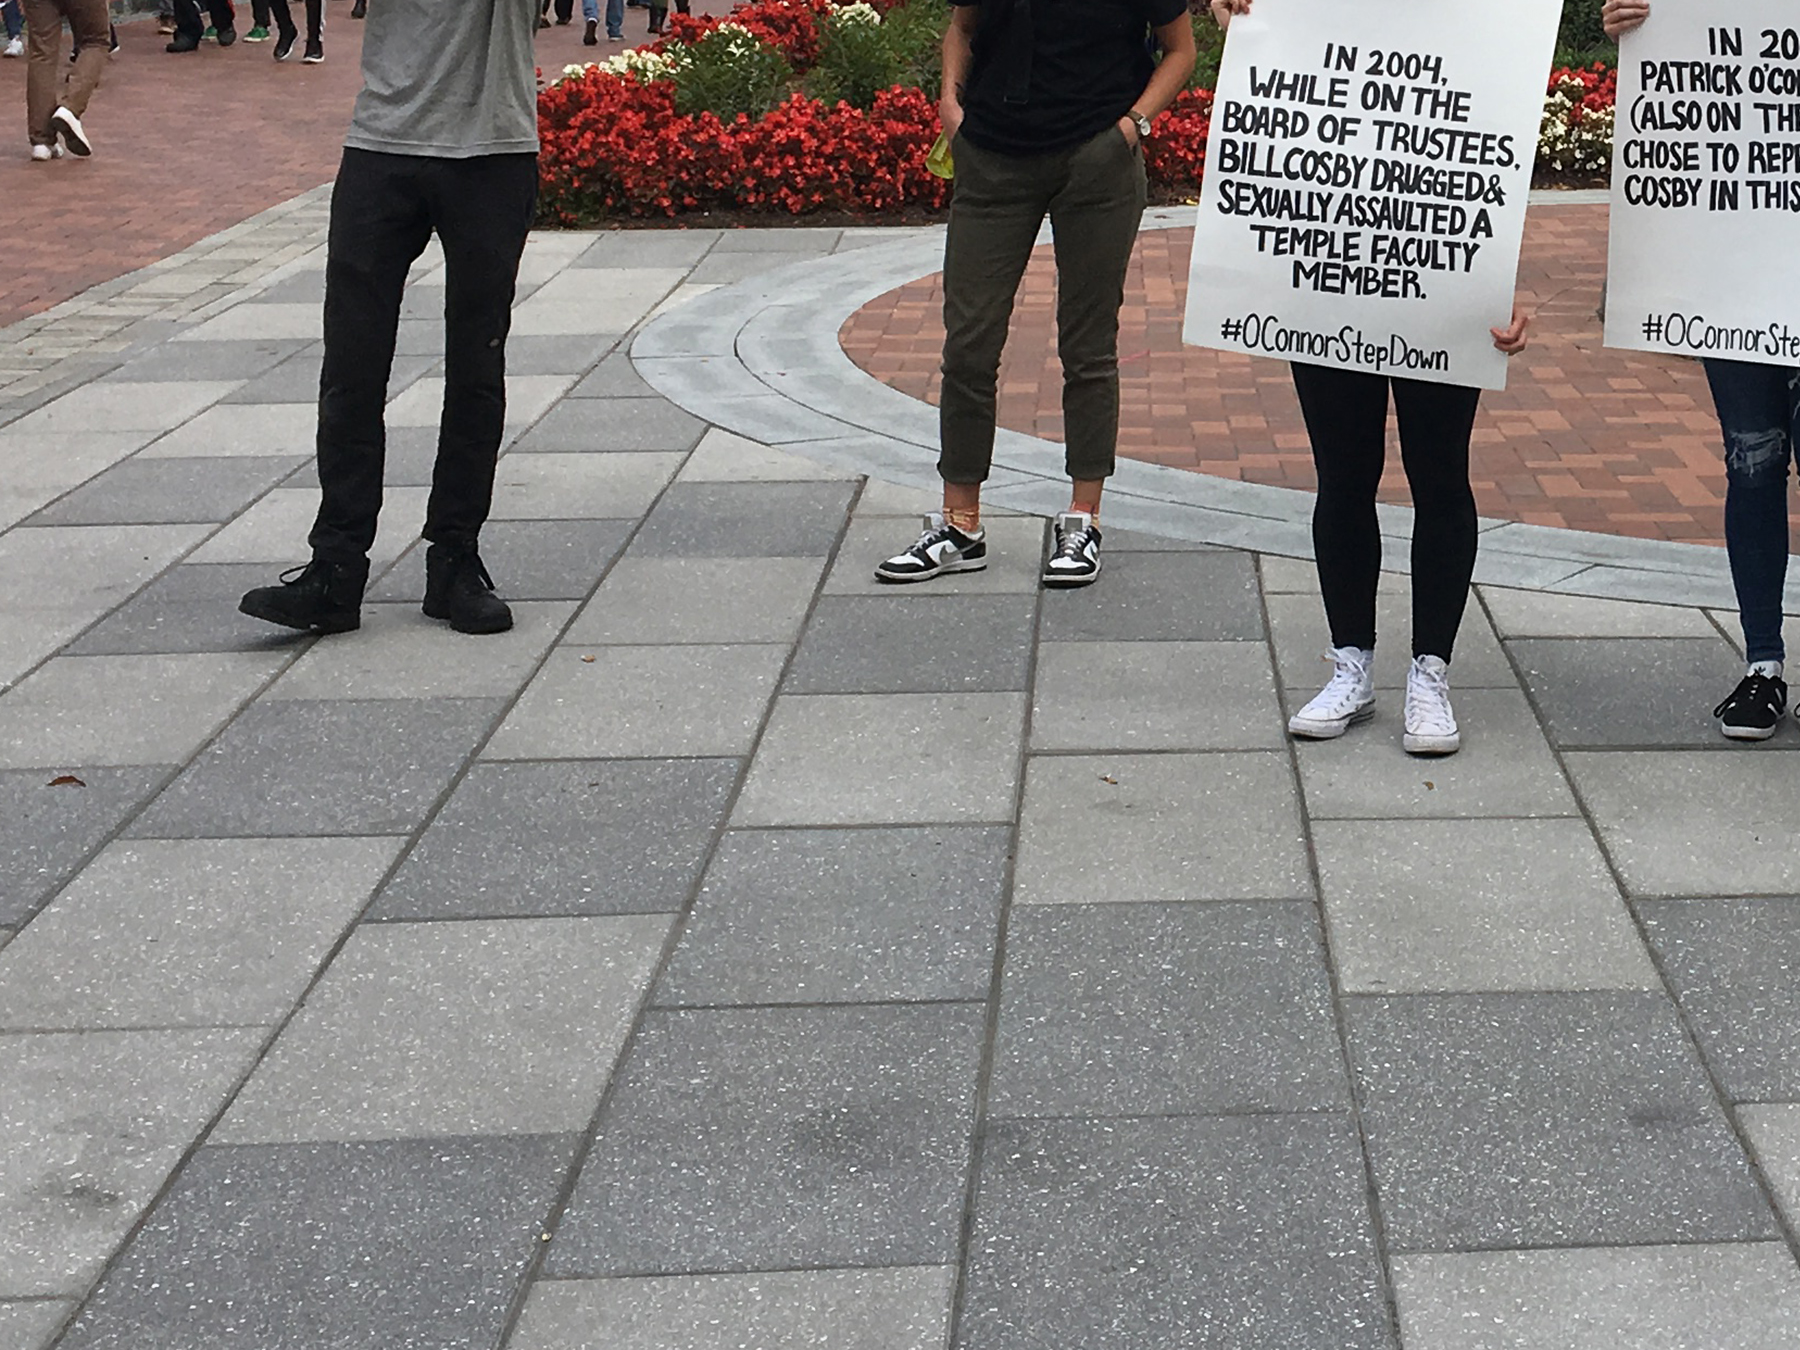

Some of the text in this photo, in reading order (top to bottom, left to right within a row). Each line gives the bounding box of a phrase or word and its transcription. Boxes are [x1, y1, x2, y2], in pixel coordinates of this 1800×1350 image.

[1708, 27, 1742, 56] IN
[1324, 43, 1447, 86] IN 2004,
[1641, 60, 1743, 96] PATRICK
[1250, 66, 1471, 122] WHILE ON THE
[1630, 94, 1702, 134] (ALSO
[1706, 101, 1741, 133] ON
[1222, 101, 1309, 139] BOARD
[1317, 114, 1361, 145] OF
[1218, 138, 1506, 207] BILL COSBY DRUGGED &
[1623, 139, 1700, 171] CHOSE
[1706, 142, 1739, 173] TO
[1217, 179, 1493, 239] SEXUALLY ASSAULTED A
[1624, 174, 1703, 208] COSBY
[1709, 180, 1738, 211] IN
[1250, 224, 1481, 273] TEMPLE FACULTY
[1293, 260, 1426, 299] MEMBER.
